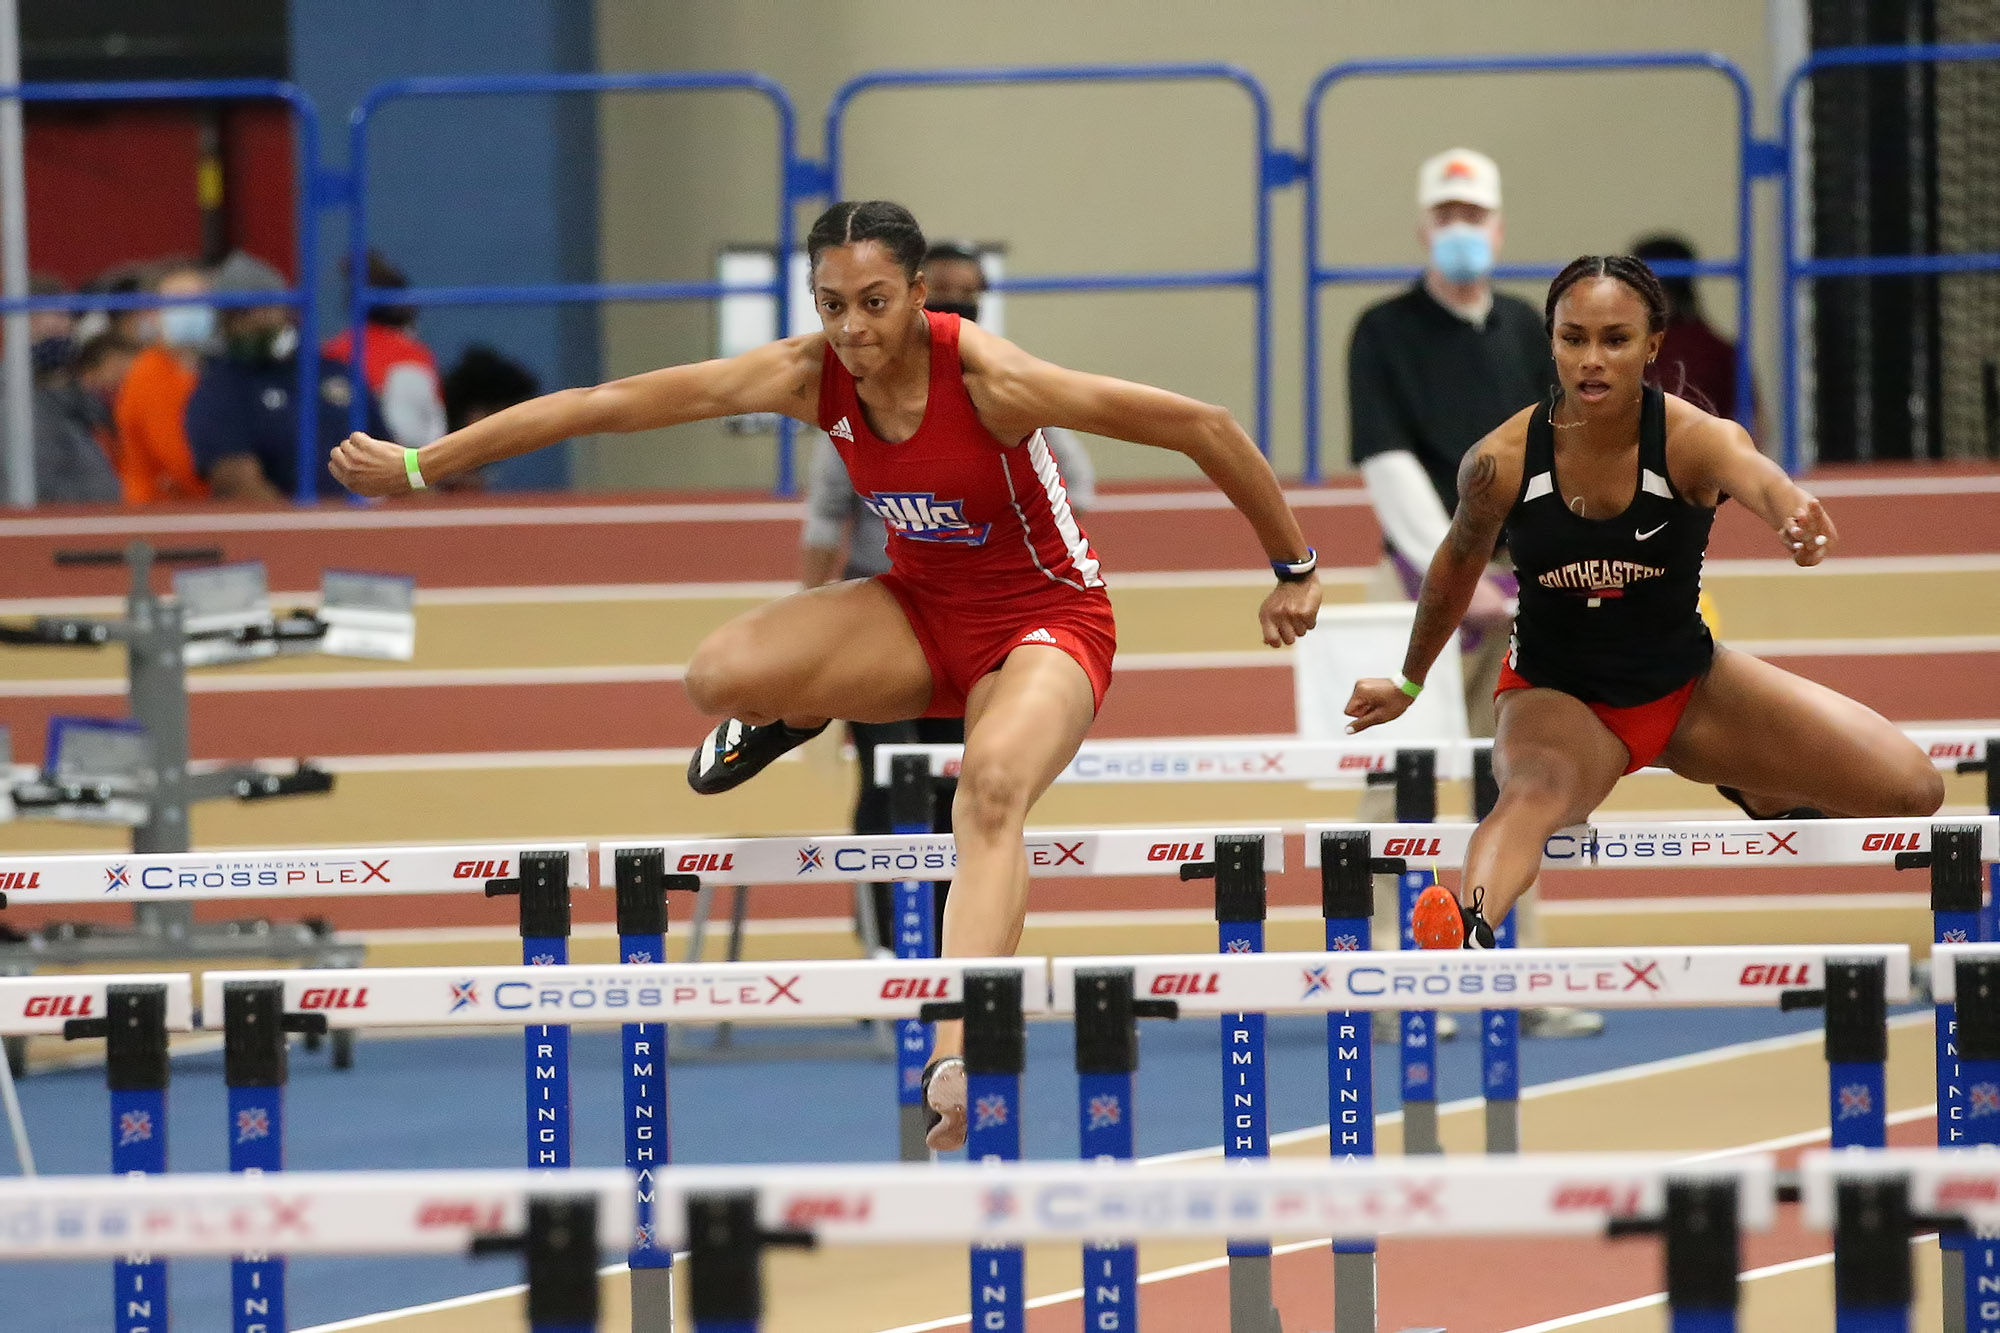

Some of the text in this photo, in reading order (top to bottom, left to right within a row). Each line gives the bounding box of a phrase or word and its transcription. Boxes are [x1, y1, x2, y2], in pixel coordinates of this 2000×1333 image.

[1544, 831, 1799, 860] CROSSPLEX
[1619, 832, 1725, 840] BIRMINGHAM
[1861, 833, 1921, 851] GILL
[1147, 843, 1205, 862] GILL
[1383, 838, 1441, 857] GILL
[215, 861, 320, 871] BIRMINGHAM
[453, 860, 511, 879] GILL
[677, 853, 734, 872] GILL
[142, 859, 391, 890] CROSSPLEX
[1150, 973, 1220, 995] GILL
[1347, 960, 1660, 996] CROSSPLEX
[1739, 964, 1811, 986] GILL
[300, 987, 369, 1010] GILL
[494, 974, 803, 1011] CROSSPLEX
[880, 977, 950, 1000] GILL
[24, 994, 94, 1018] GILL
[633, 1023, 655, 1203] IRMINGHAM
